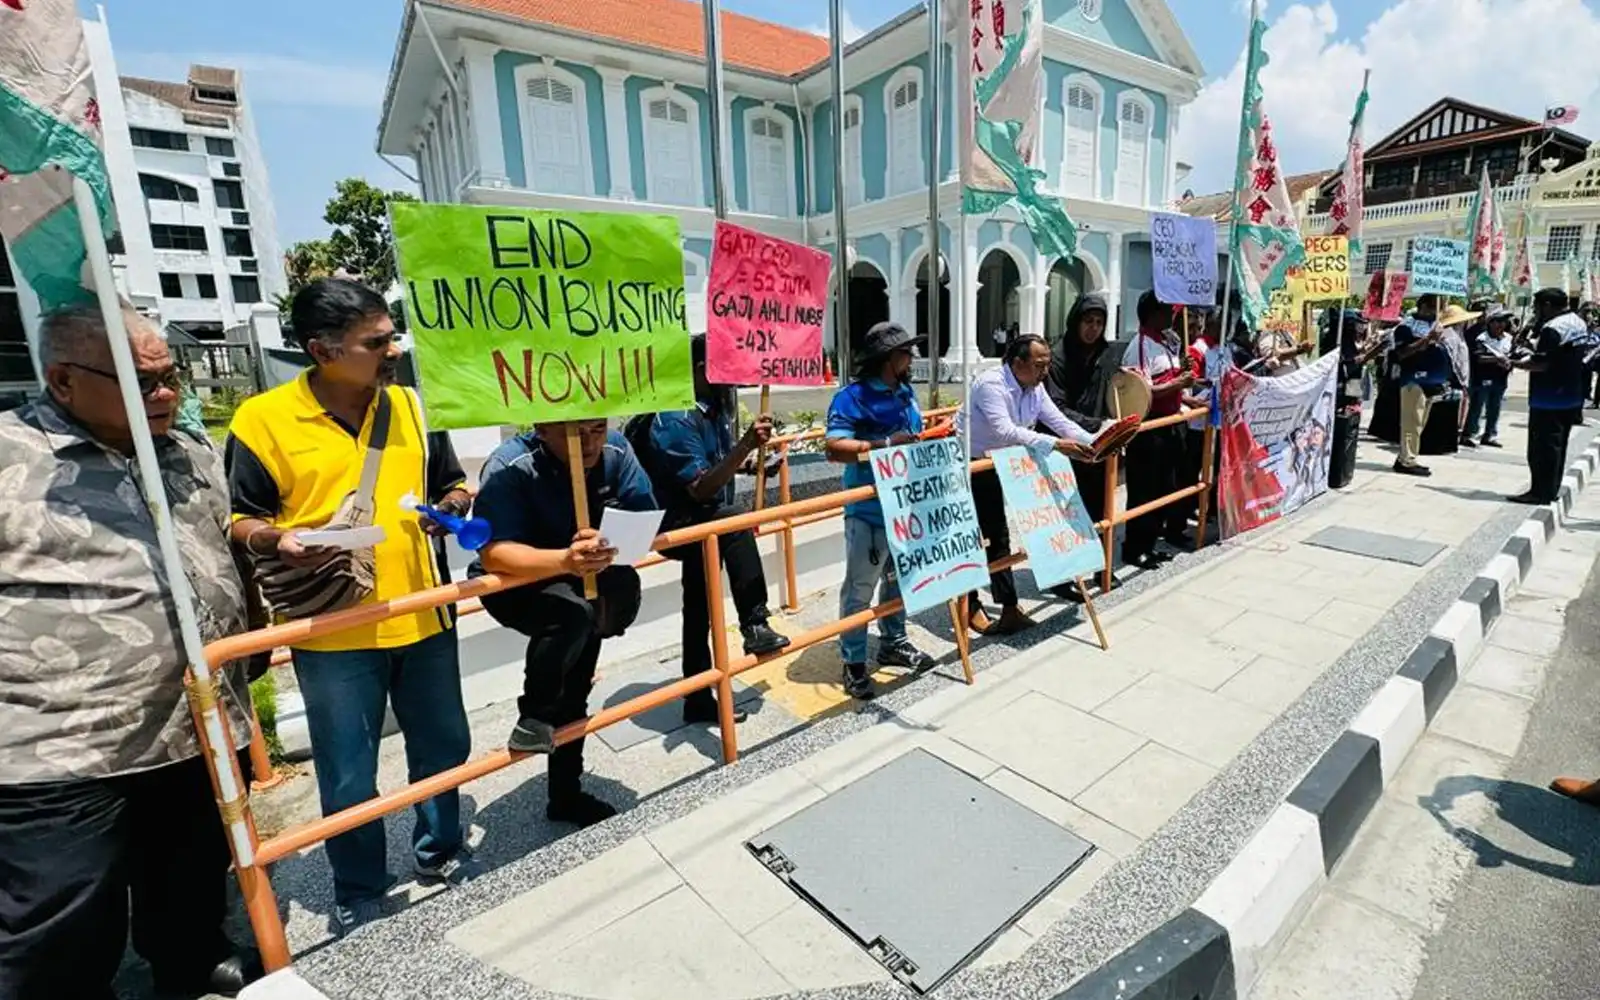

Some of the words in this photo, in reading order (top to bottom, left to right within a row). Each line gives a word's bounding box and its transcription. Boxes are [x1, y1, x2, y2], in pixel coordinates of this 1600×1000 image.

[1542, 190, 1570, 200] CHINESE
[485, 214, 592, 270] END
[718, 228, 757, 255] GAJI
[760, 242, 793, 268] CEO
[1304, 237, 1340, 253] PECT
[1303, 254, 1347, 273] KERS
[753, 270, 776, 292] 52
[779, 274, 812, 297] JUTA
[408, 274, 549, 333] UNION
[559, 278, 687, 337] BUSTING
[712, 290, 754, 321] GAJI
[759, 298, 791, 323] AHLI
[760, 357, 821, 379] SETAHUN
[876, 449, 909, 481] NO
[910, 440, 965, 470] UNFAIR
[892, 467, 971, 509] TREATMENT
[893, 512, 924, 541] NO
[928, 503, 974, 533] MORE
[897, 527, 983, 578] EXPLOITATION
